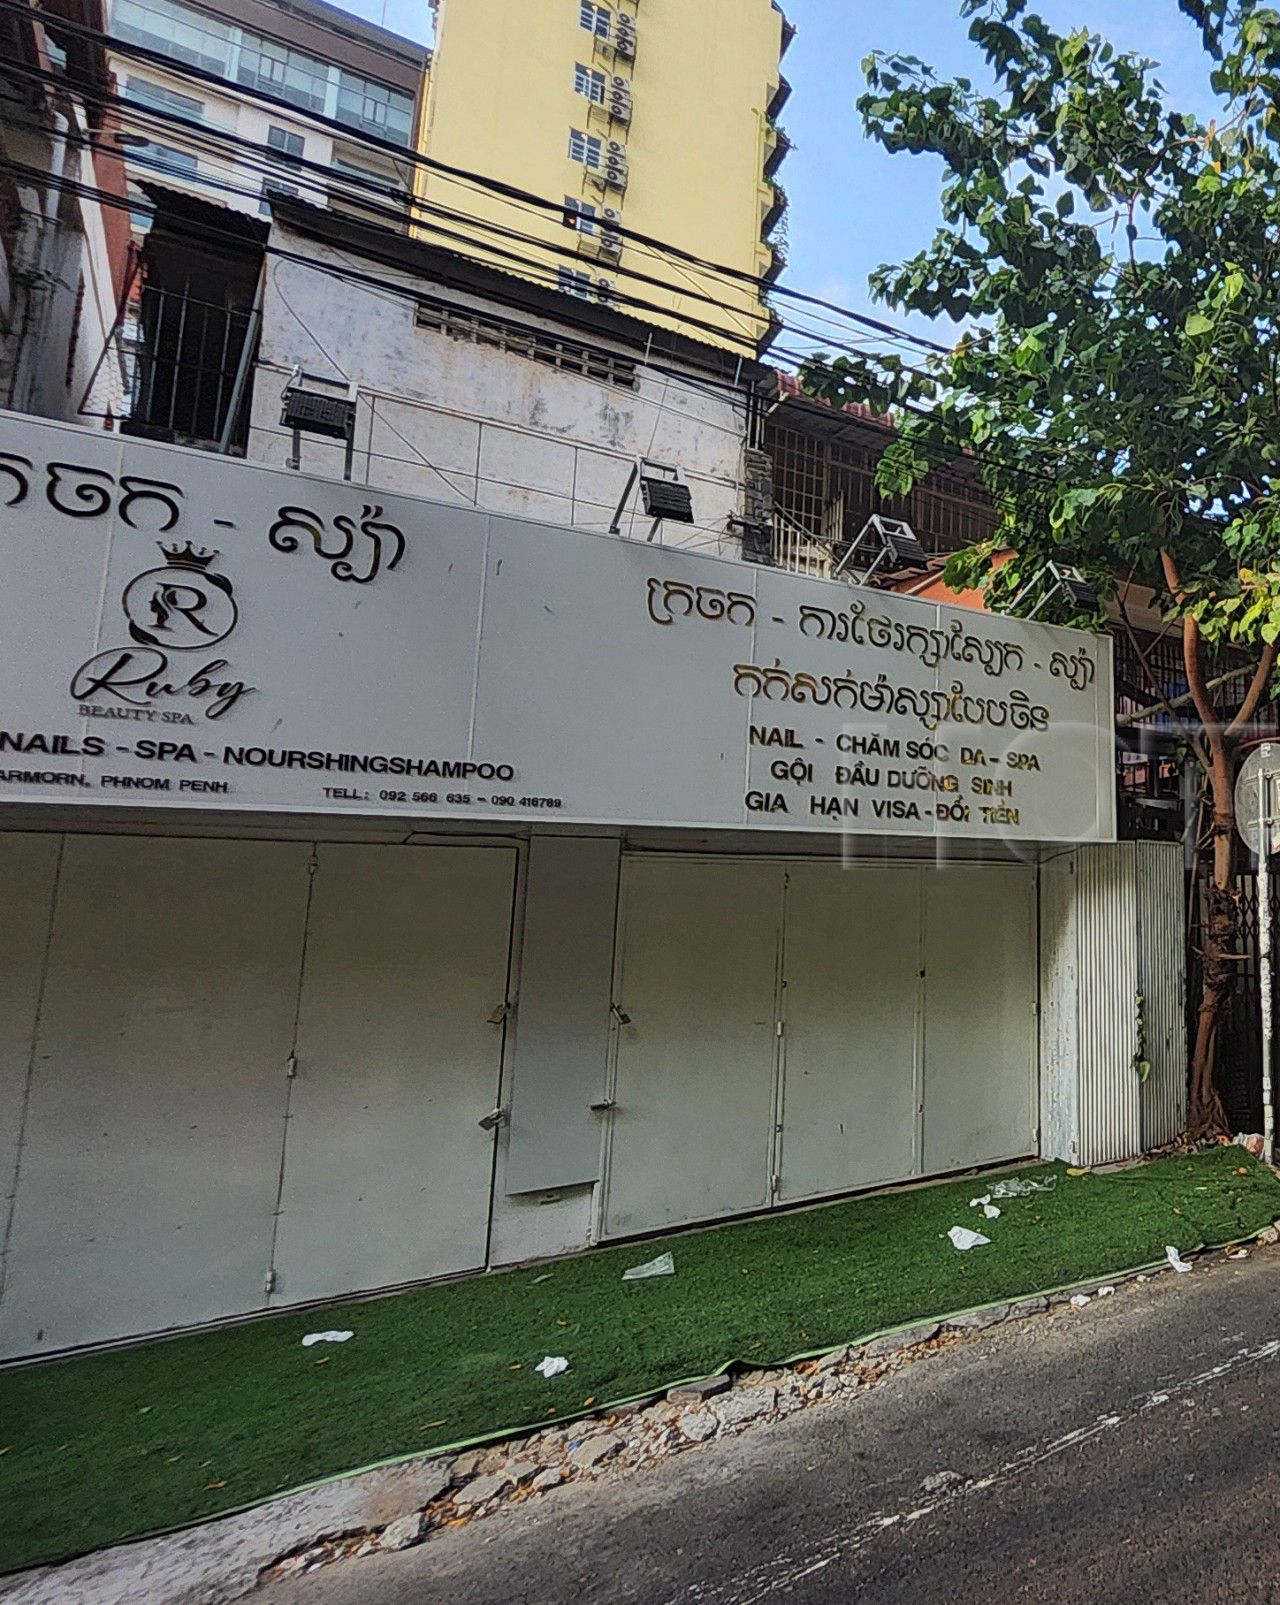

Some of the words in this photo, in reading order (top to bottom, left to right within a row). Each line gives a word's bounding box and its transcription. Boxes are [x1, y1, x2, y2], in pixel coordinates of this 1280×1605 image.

[647, 578, 756, 627] ក្រចក
[70, 646, 257, 720] Ruby
[79, 704, 156, 722] BEAUTY
[161, 711, 195, 726] SPA
[0, 731, 106, 757] NAILS
[135, 740, 198, 763] SPA
[223, 746, 515, 782] NOURSHINGSHAMPOO
[749, 725, 803, 749] NAIL
[836, 732, 901, 759] CHĂM
[906, 737, 951, 762] SÓC
[1006, 751, 1042, 772] SPA
[100, 775, 171, 790] PHNOM
[179, 779, 229, 793] PENH
[771, 757, 814, 787] GỘI
[835, 759, 881, 787] ĐẦU
[971, 776, 1014, 797] SINH
[379, 790, 406, 801] 092
[412, 792, 438, 803] 566
[446, 793, 471, 804] 635
[491, 795, 515, 806] 090
[745, 790, 787, 813] GIA
[810, 796, 859, 821] HẠN
